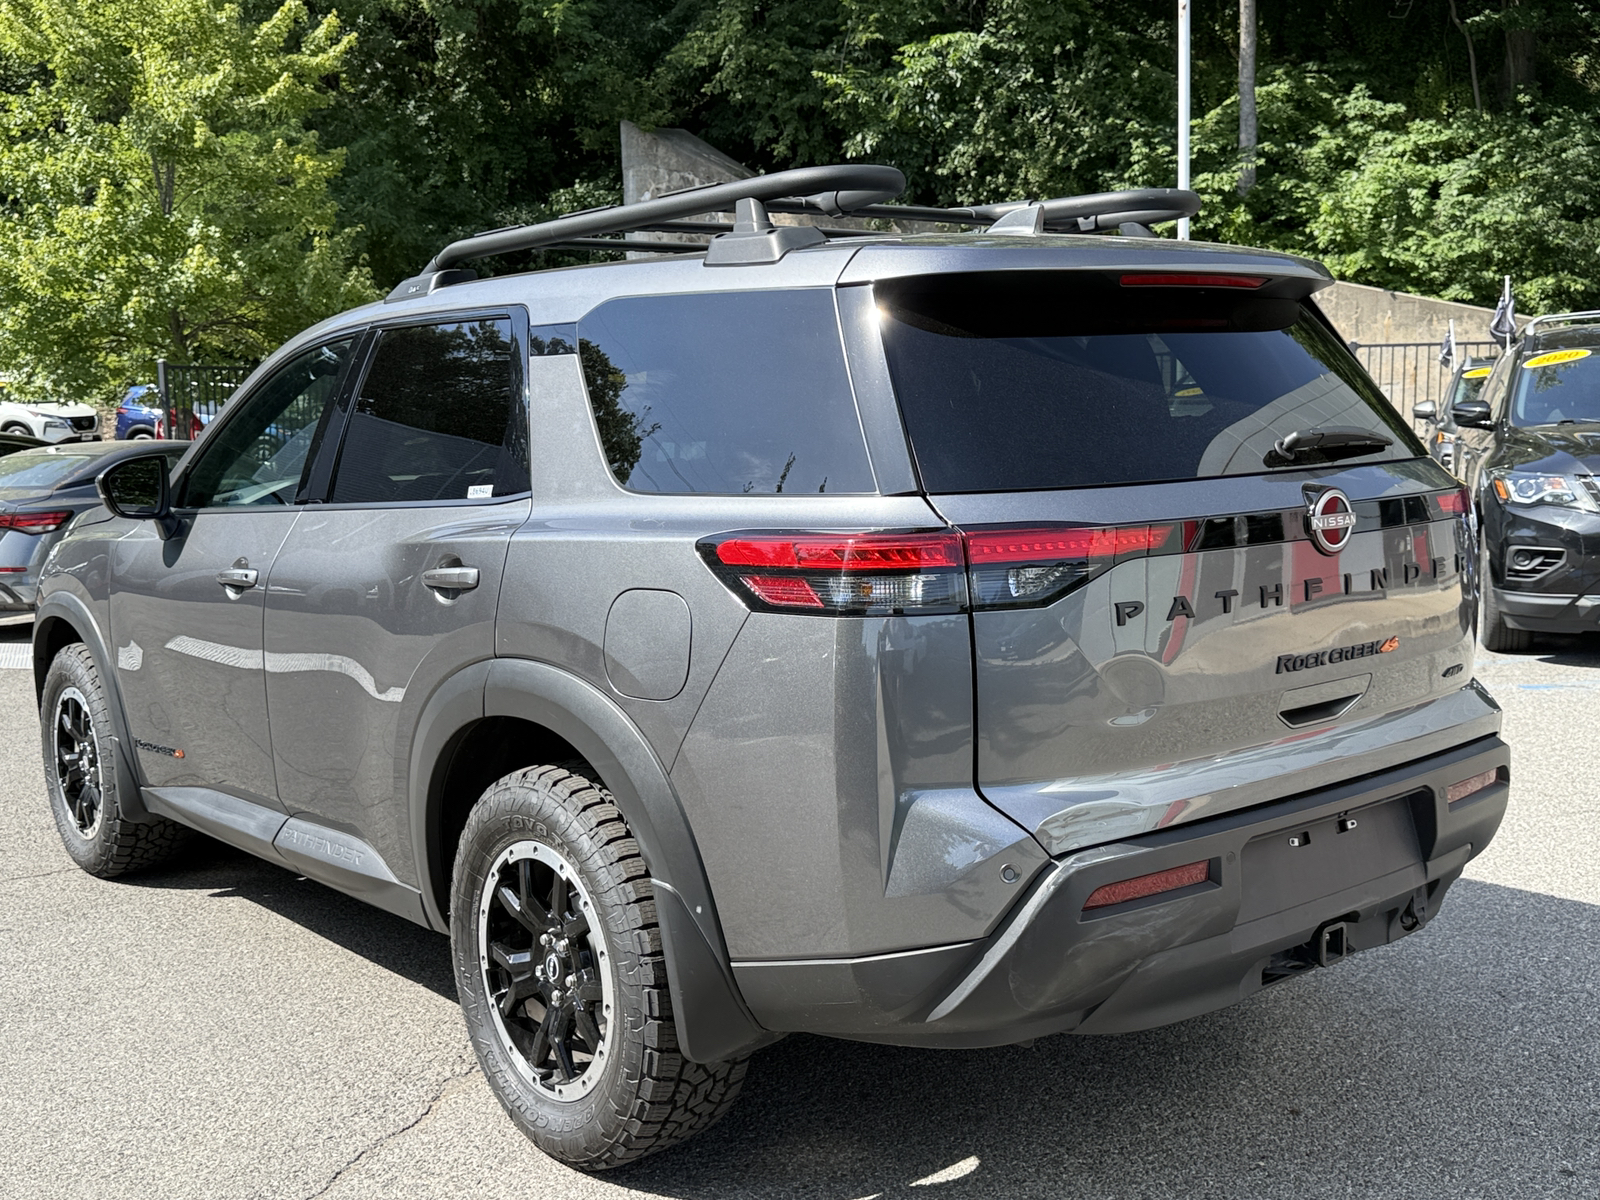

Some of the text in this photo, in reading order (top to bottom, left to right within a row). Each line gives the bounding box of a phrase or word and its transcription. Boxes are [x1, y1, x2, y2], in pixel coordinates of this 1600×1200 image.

[1313, 514, 1356, 528] NISSAN
[1114, 552, 1467, 627] PATHFINDER
[500, 814, 549, 837] TOYO
[281, 826, 364, 866] PATHFINDER
